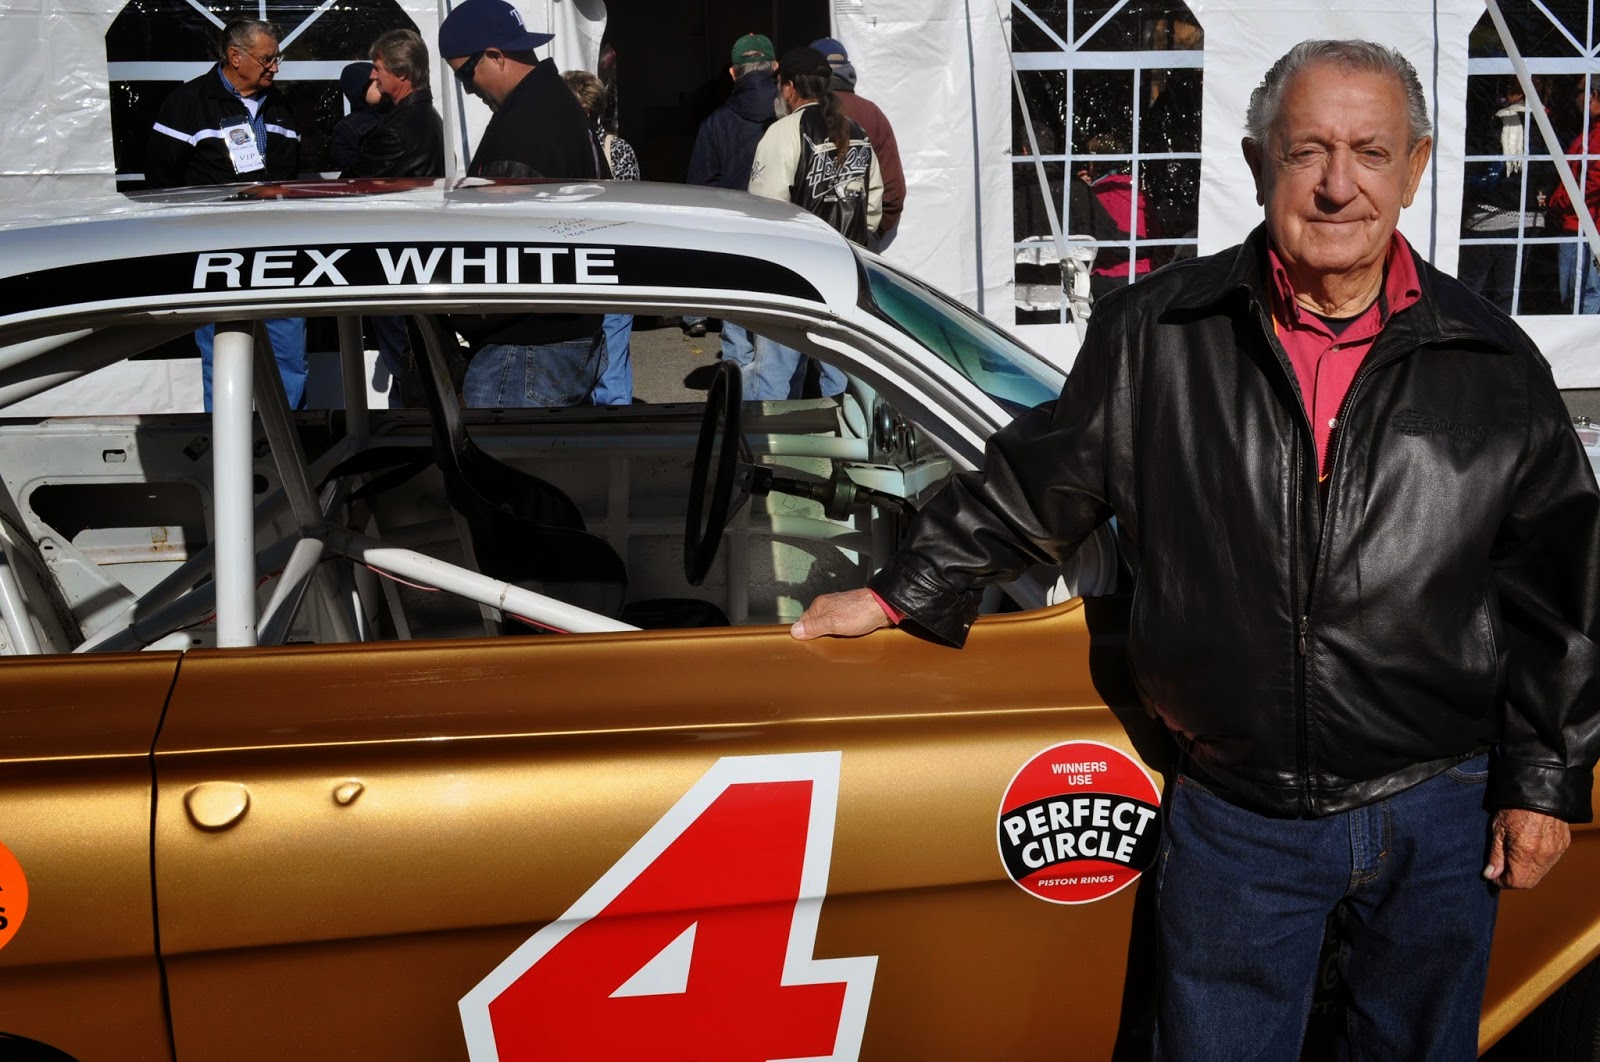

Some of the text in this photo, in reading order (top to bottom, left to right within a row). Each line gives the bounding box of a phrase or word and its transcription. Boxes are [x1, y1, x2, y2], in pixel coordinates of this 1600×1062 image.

[239, 153, 255, 161] VIP
[193, 247, 619, 289] REX WHITE
[1051, 761, 1108, 774] WINNERS
[1068, 774, 1093, 786] USE
[1003, 798, 1157, 847] PERFECT
[1022, 830, 1137, 869] CIRCLE
[1037, 875, 1115, 887] PISTON RINGS
[458, 751, 879, 1062] 4
